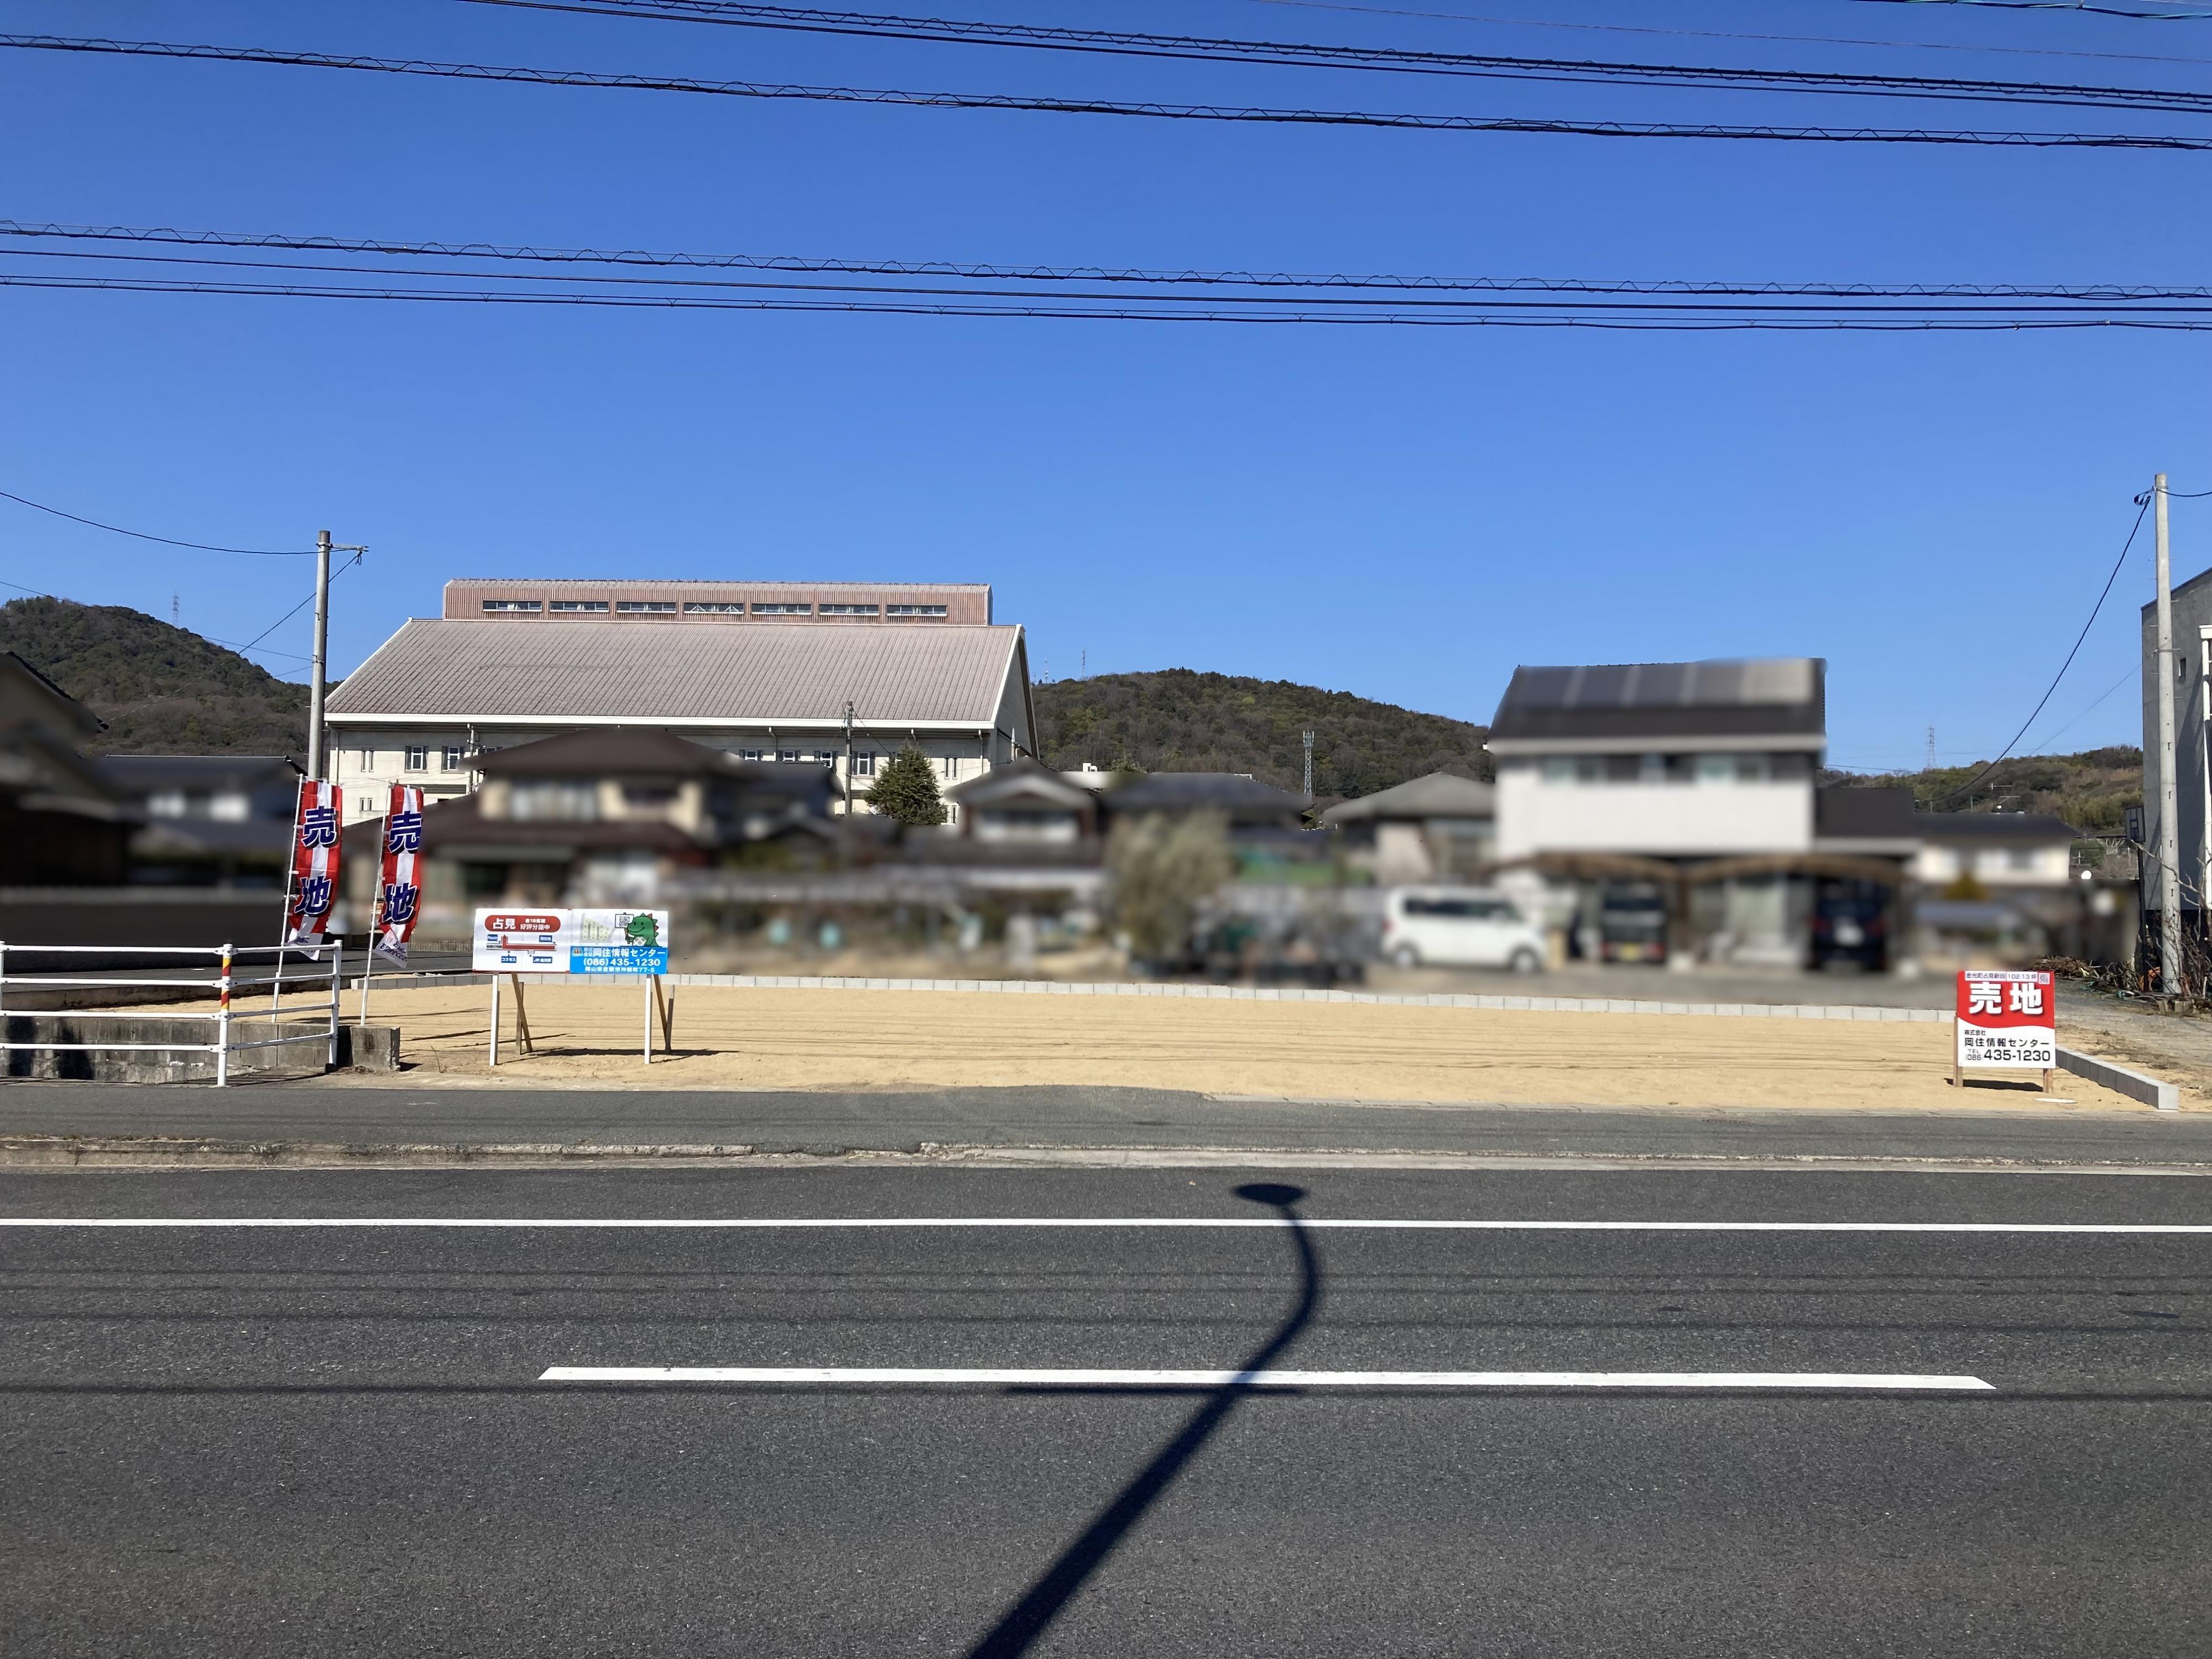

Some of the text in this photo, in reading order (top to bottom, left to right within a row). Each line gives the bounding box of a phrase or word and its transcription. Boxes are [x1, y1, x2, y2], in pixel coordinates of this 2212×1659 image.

[295, 806, 337, 915] 売地
[382, 811, 422, 924] 売地
[493, 918, 516, 930] 占見
[593, 947, 666, 957] 岡住情報センター
[1969, 982, 2043, 1014] 売地
[1965, 1037, 2049, 1047] 岡住情報センター
[1984, 1049, 2051, 1061] 435-1230
